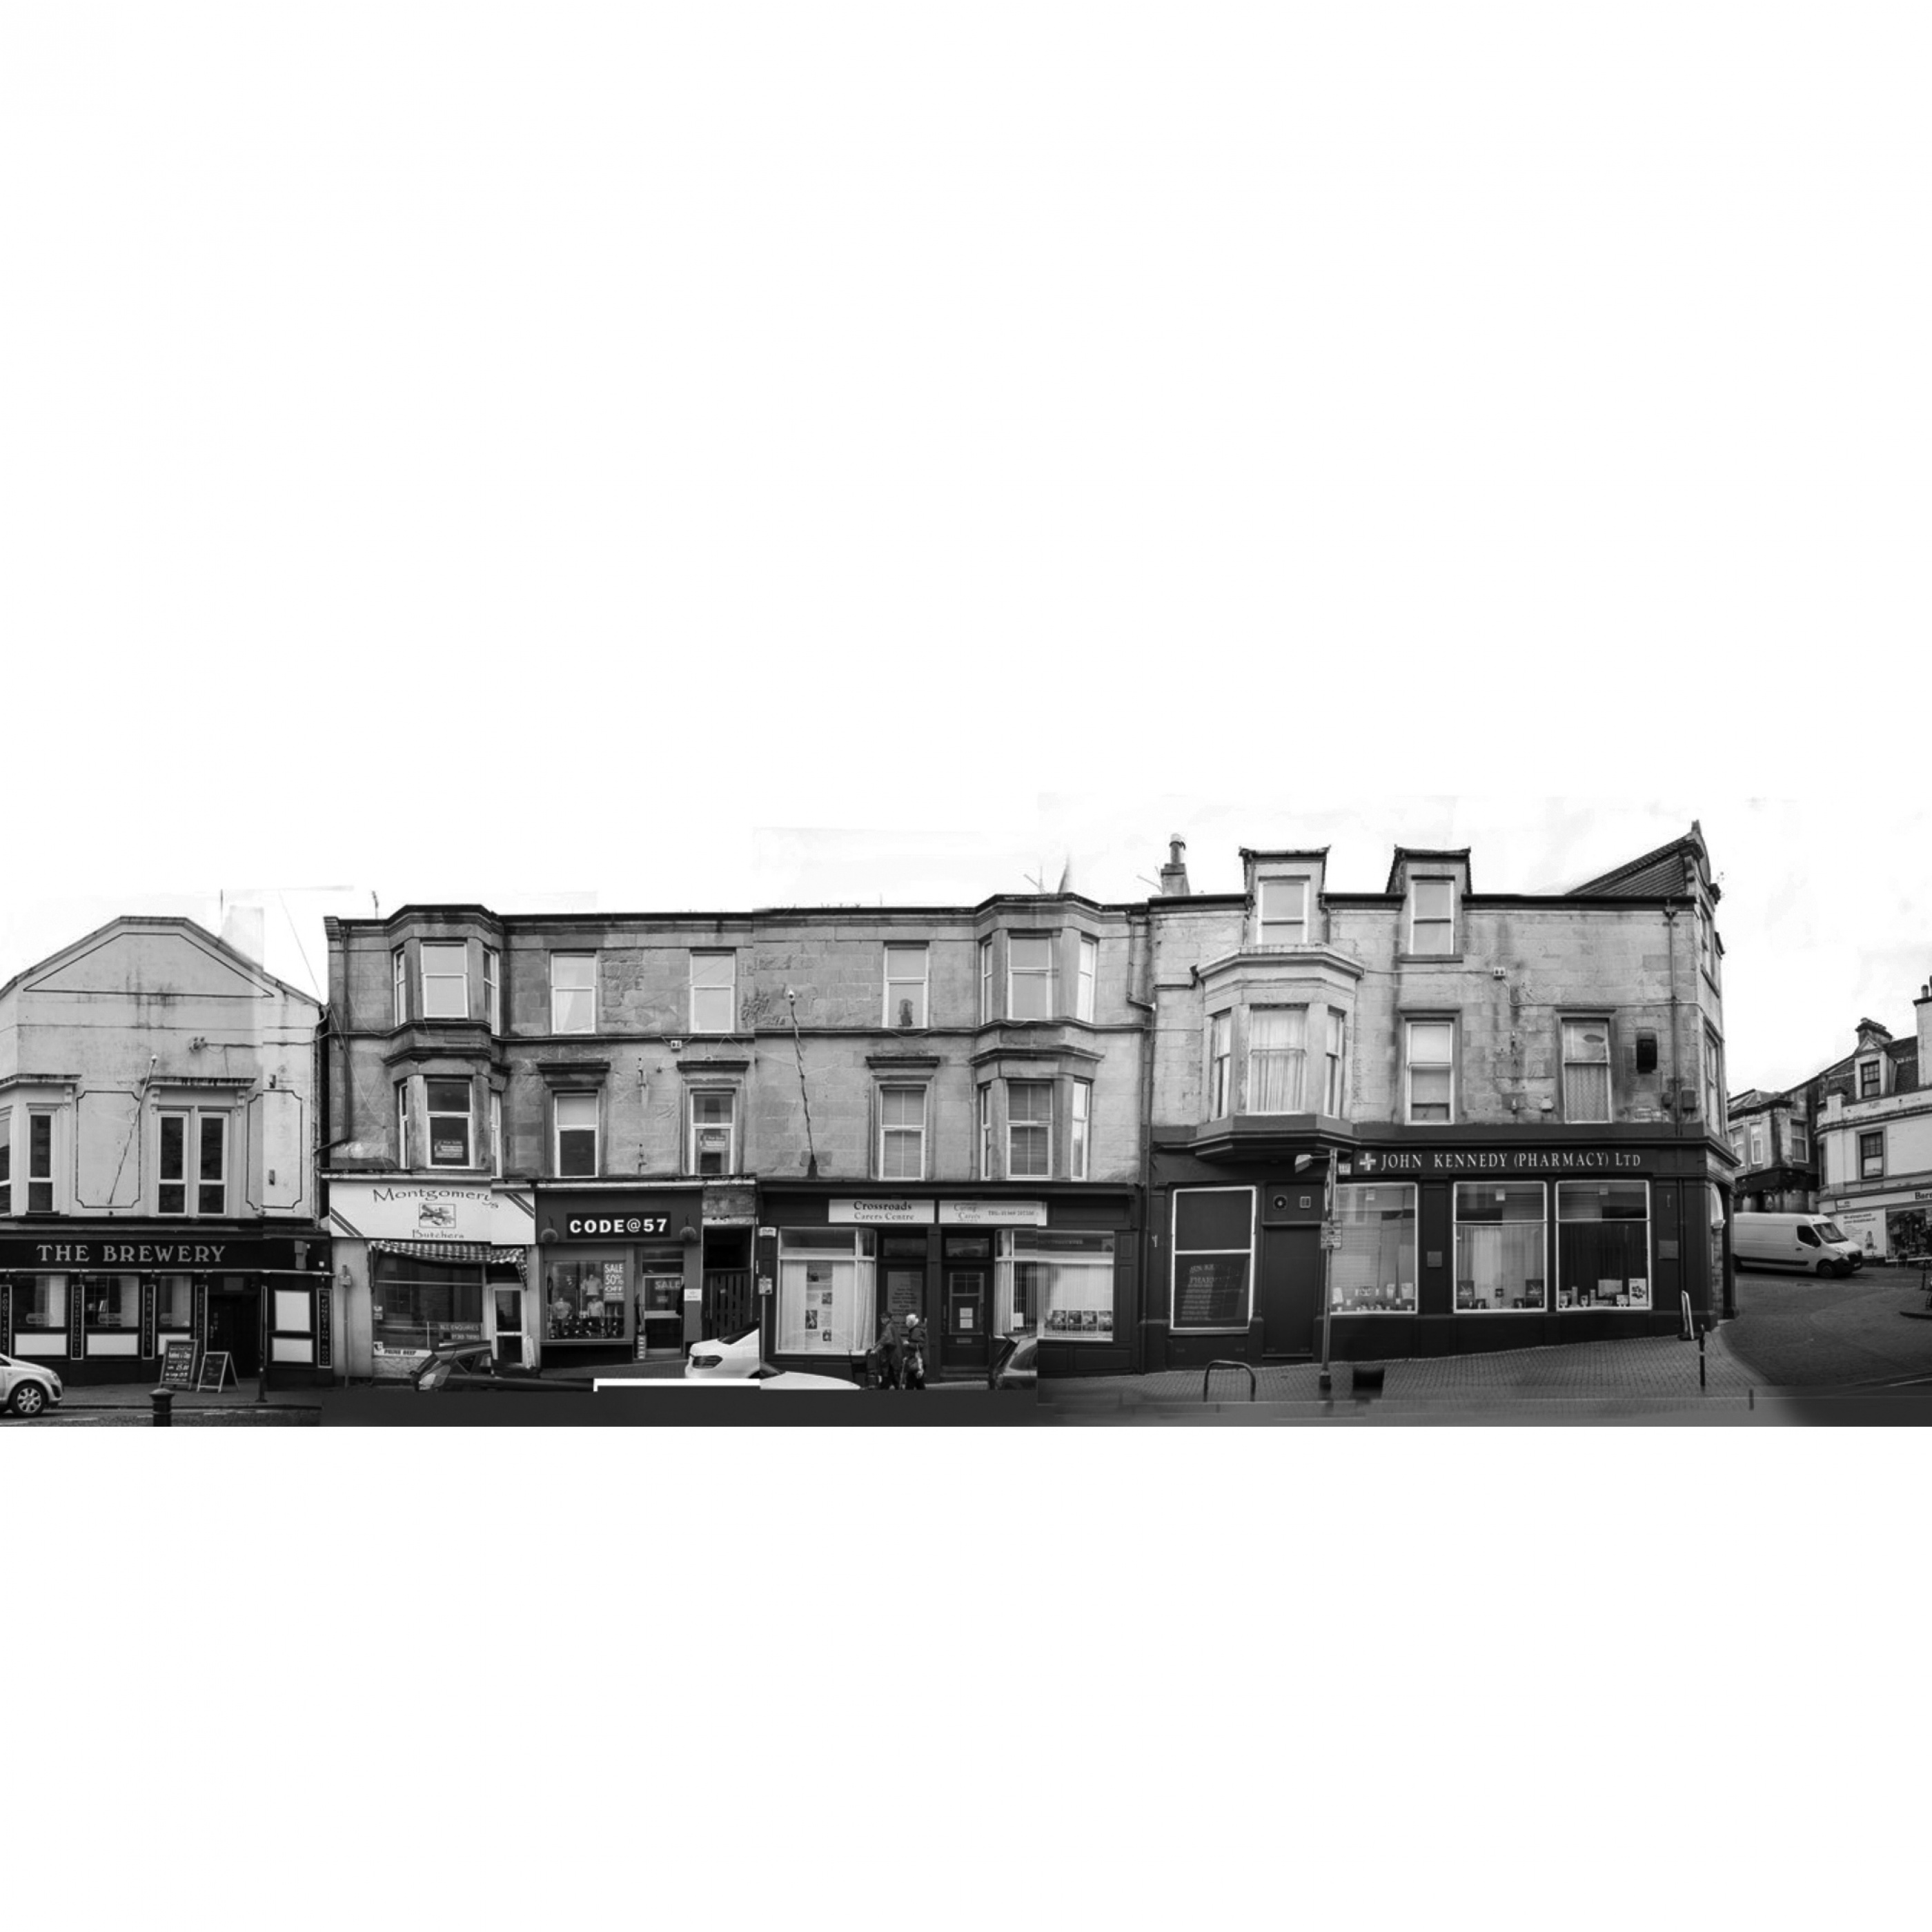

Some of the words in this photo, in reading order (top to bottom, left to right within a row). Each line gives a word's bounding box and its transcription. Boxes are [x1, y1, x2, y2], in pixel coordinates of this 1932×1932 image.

[1381, 1154, 1422, 1171] JOHN
[1434, 1154, 1508, 1167] KENNEDY
[1514, 1152, 1609, 1169] (PHARMACY)
[854, 1201, 913, 1210] Crossroads
[885, 1212, 915, 1221] Centre
[569, 1218, 668, 1234] CODE@57
[36, 1244, 90, 1262] THE
[102, 1245, 226, 1262] BREWERY
[604, 1263, 624, 1274] SALE
[605, 1274, 624, 1285] 50%
[655, 1280, 680, 1291] SALE
